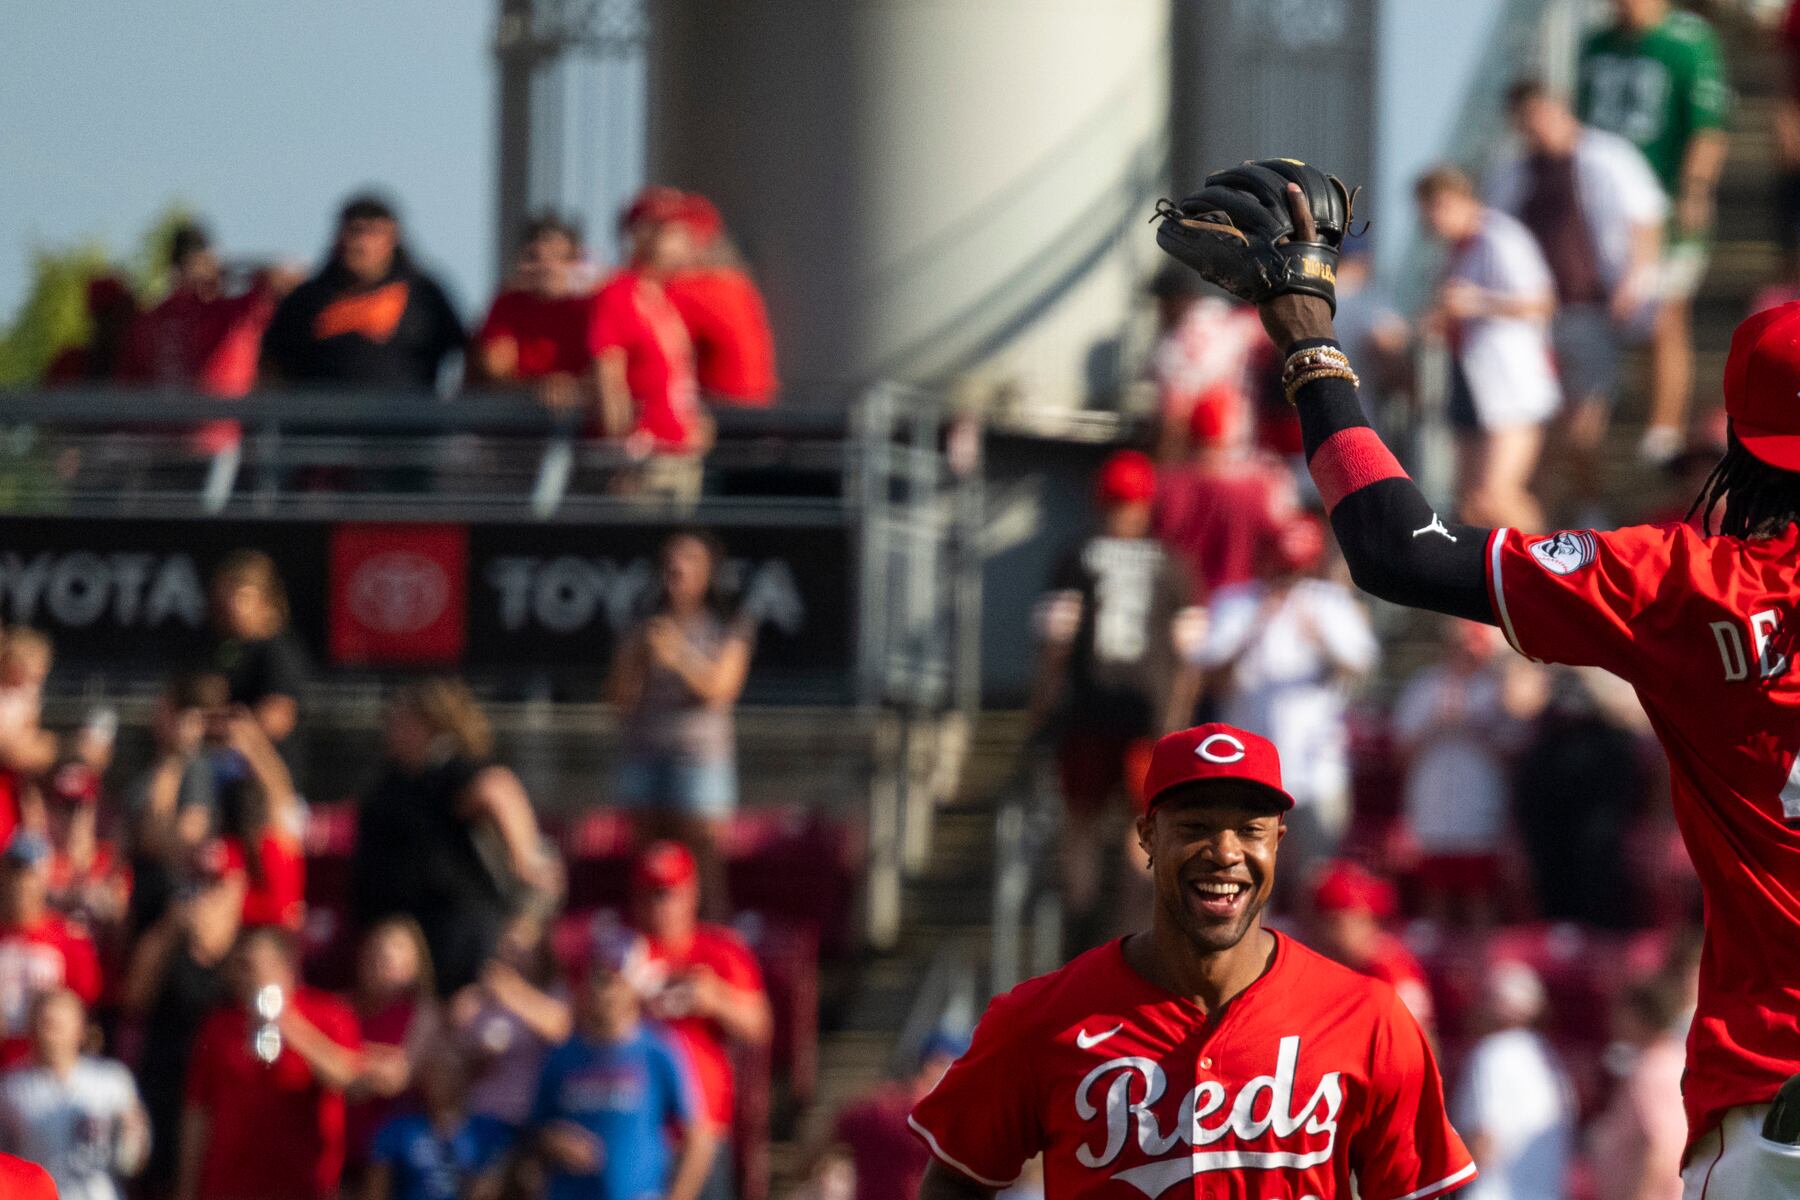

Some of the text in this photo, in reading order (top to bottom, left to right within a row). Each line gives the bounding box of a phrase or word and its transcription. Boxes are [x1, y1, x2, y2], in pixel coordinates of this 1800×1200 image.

[483, 555, 805, 631] TOYA
[1193, 733, 1246, 764] C
[1075, 1035, 1343, 1170] Reds
